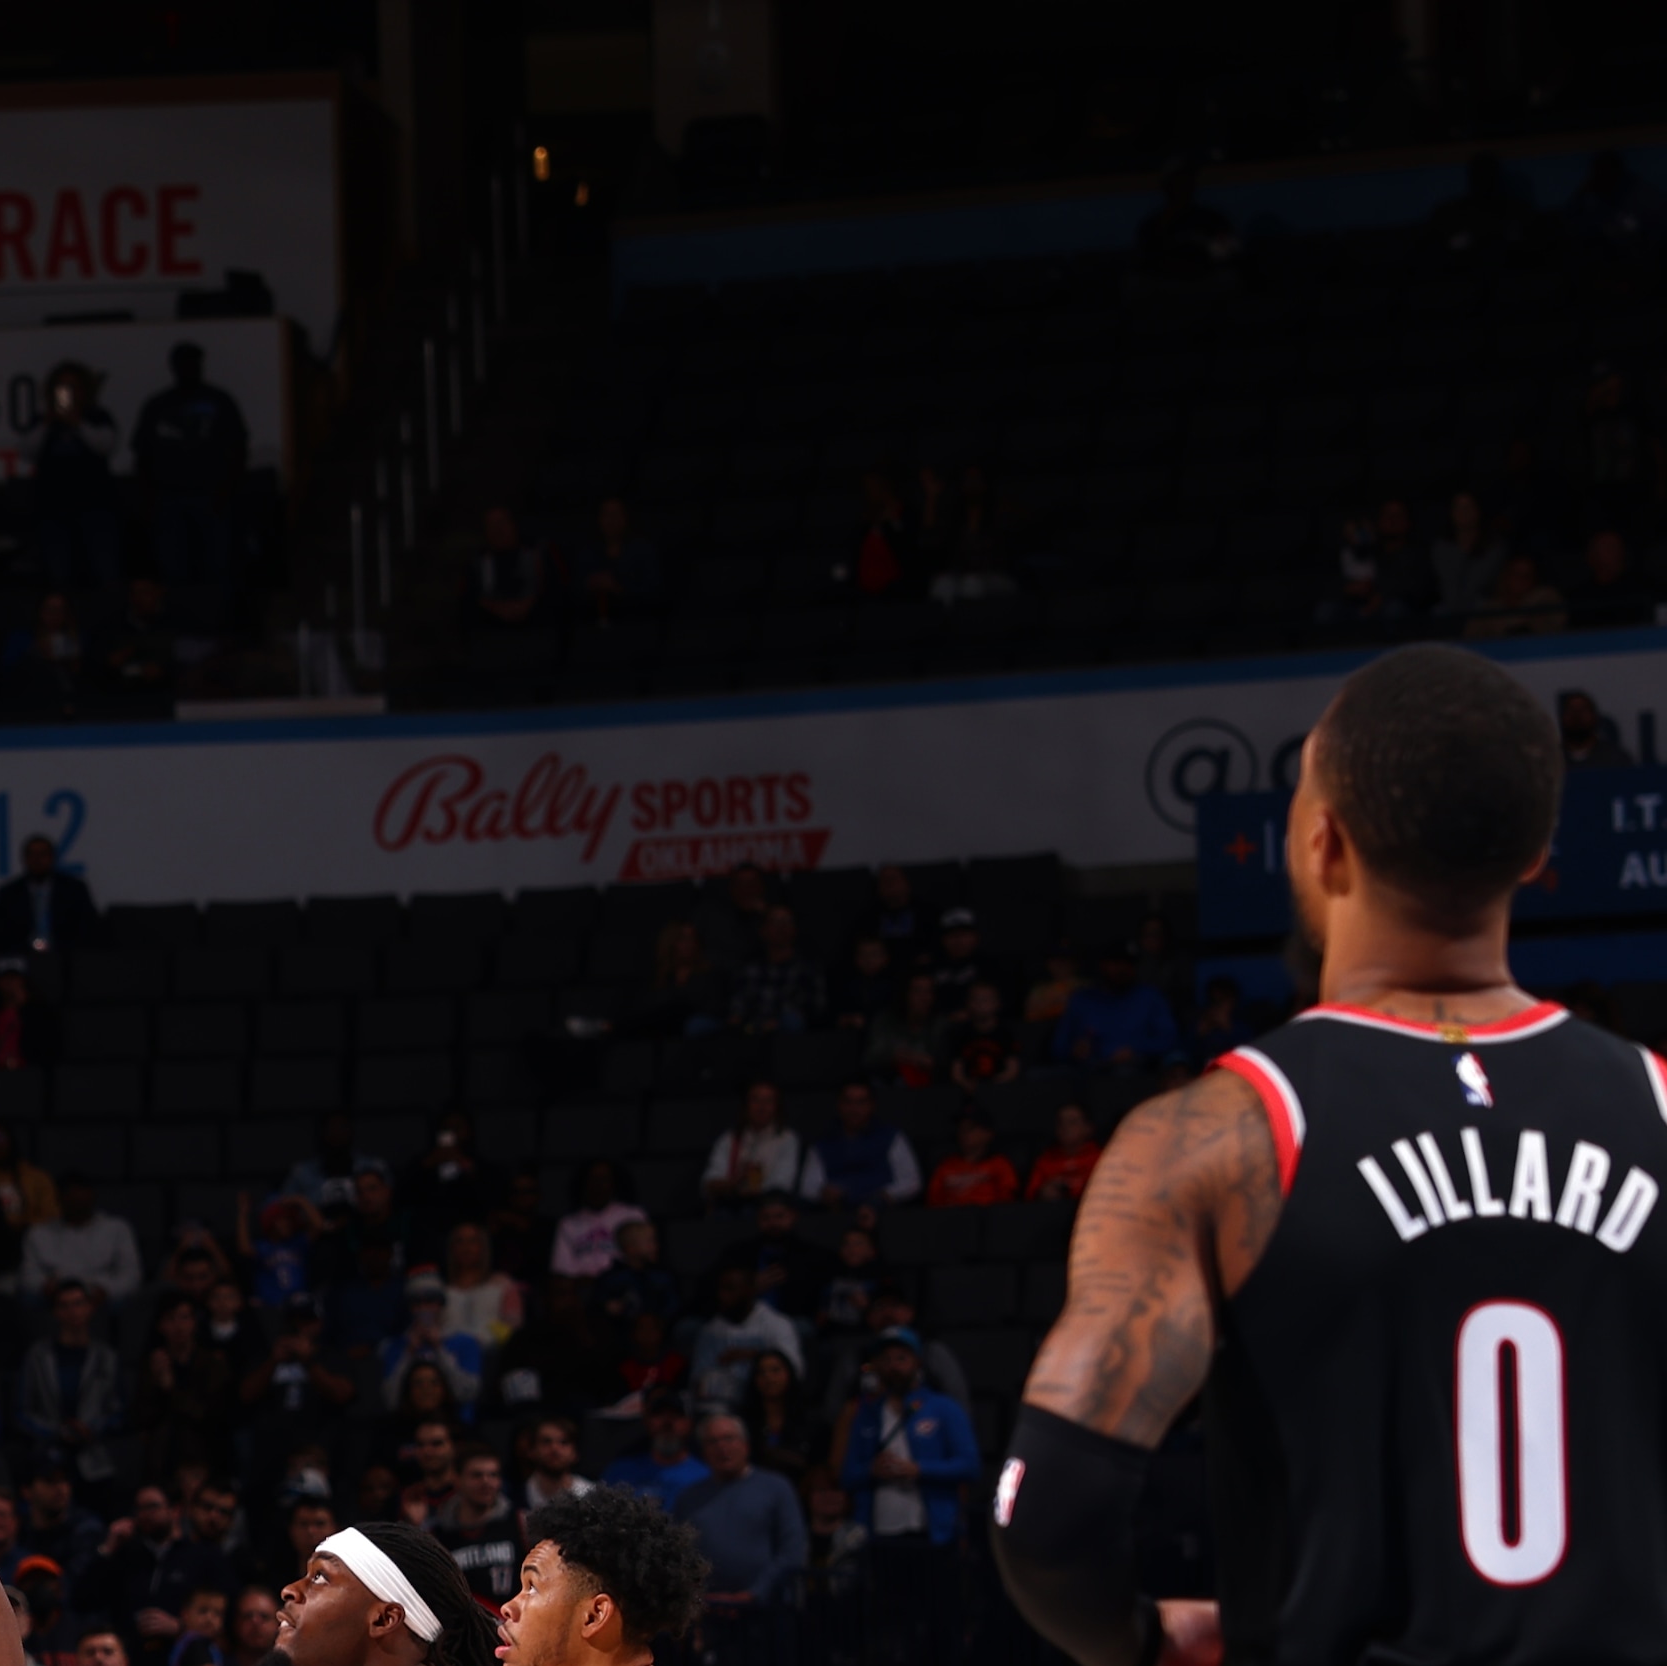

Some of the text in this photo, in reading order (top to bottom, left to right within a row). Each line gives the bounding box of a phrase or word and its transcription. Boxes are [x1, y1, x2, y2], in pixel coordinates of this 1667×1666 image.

[373, 752, 811, 862] Bally SPORTS
[1357, 1127, 1659, 1254] LILLARD
[1455, 1297, 1568, 1588] 0
